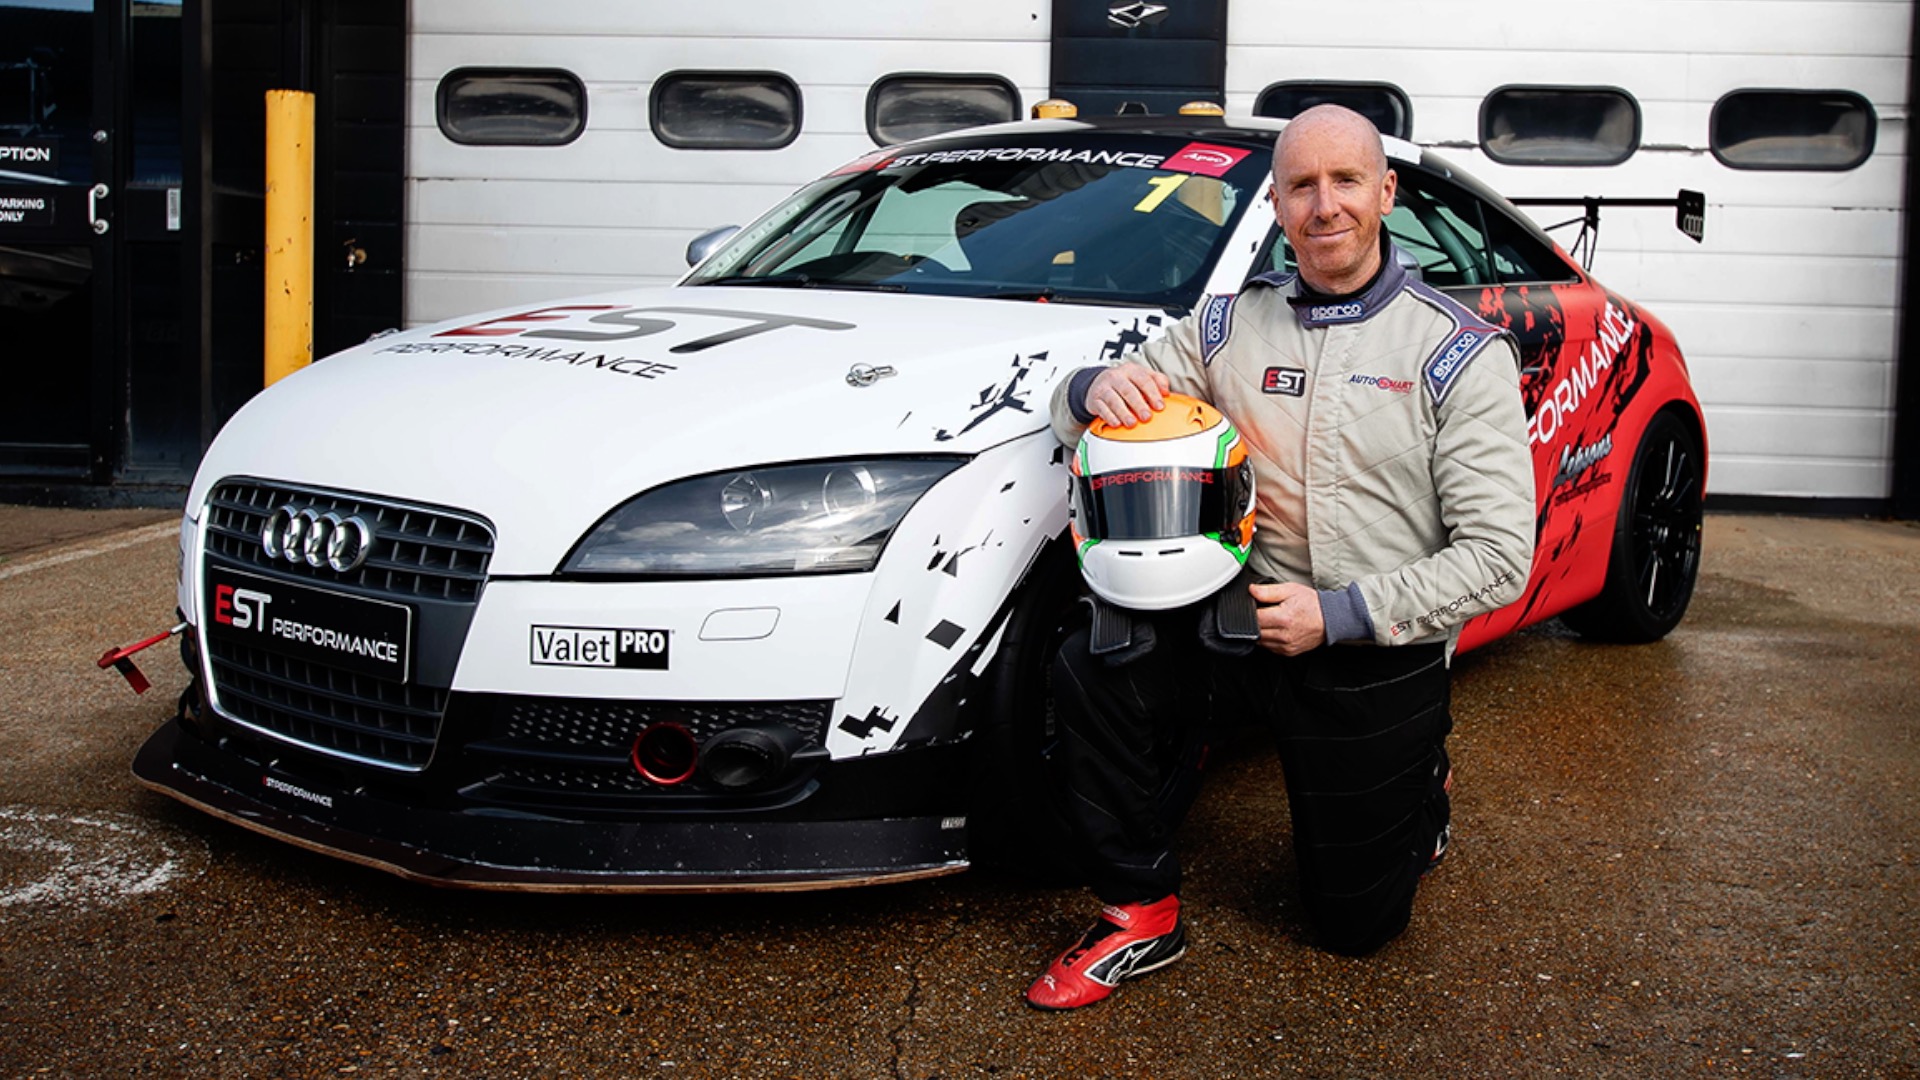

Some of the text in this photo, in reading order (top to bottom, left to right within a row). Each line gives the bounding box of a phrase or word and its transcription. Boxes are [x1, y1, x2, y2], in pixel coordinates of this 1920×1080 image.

[1134, 173, 1190, 213] 1
[431, 305, 857, 354] EST
[1311, 304, 1363, 320] sparco
[373, 343, 678, 379] PERFORMANCE
[1433, 332, 1477, 380] sparco
[1265, 369, 1305, 390] EST
[215, 584, 398, 663] EST PERFORMANCE
[1390, 620, 1412, 637] EST
